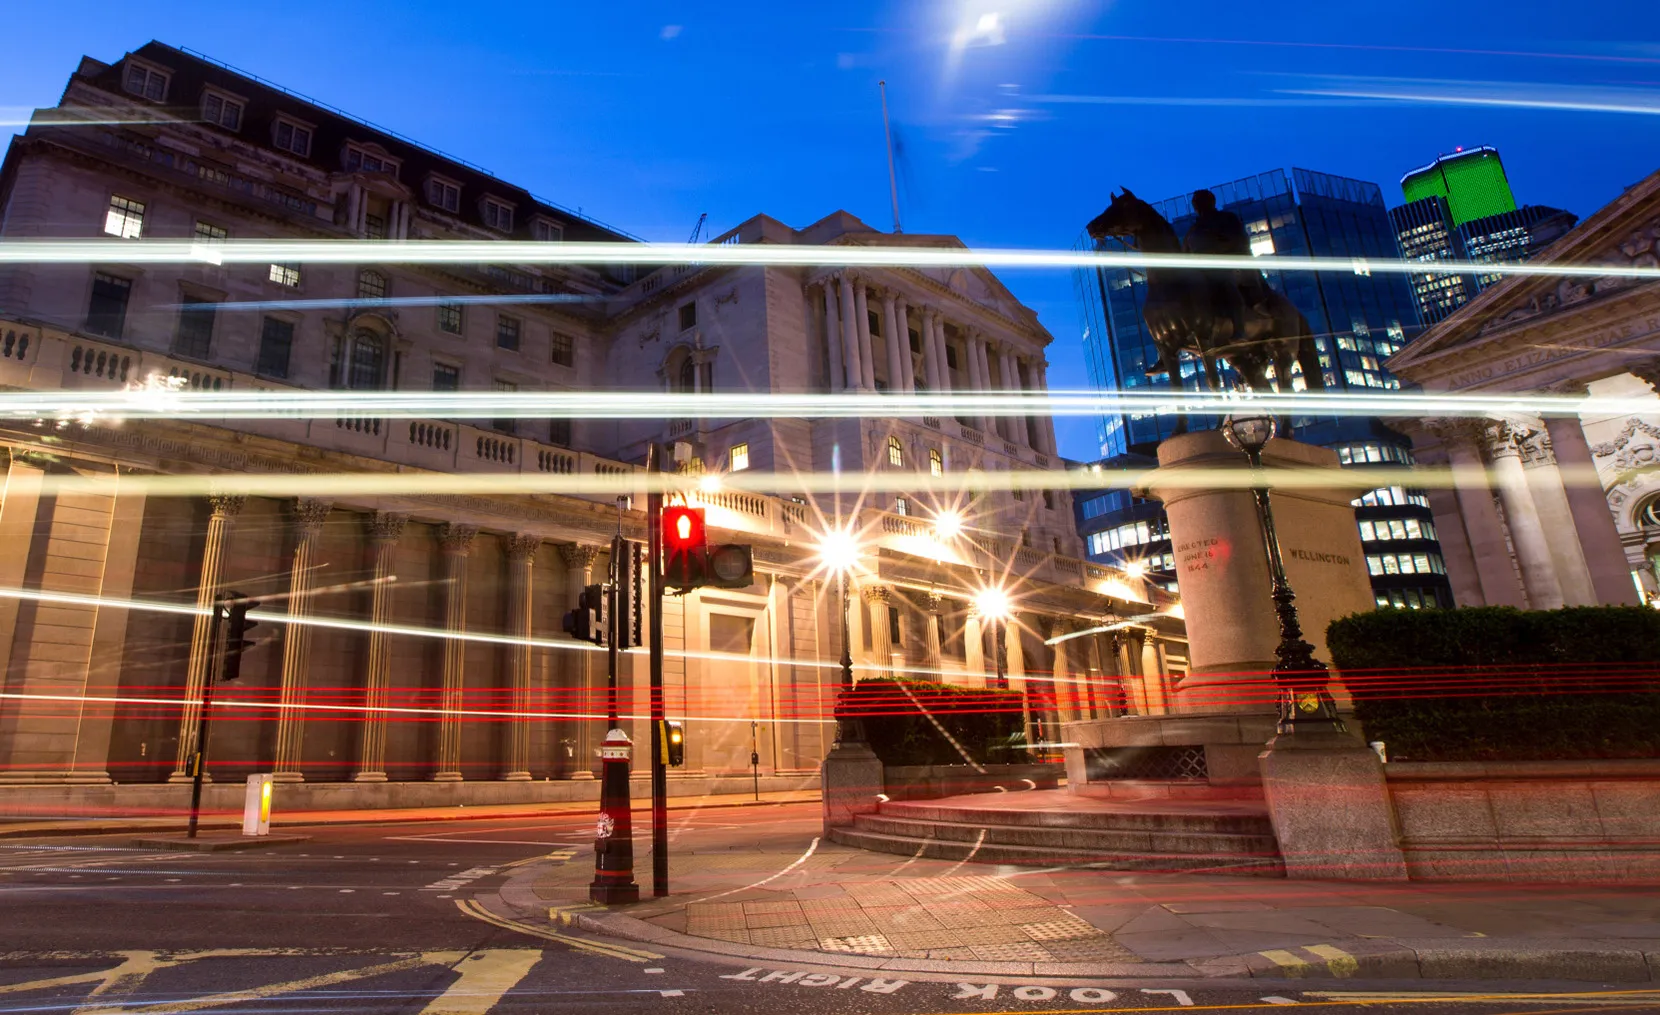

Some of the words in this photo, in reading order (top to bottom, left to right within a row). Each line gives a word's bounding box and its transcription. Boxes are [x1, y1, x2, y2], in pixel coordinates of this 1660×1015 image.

[1449, 367, 1493, 391] ANNO
[1177, 538, 1219, 553] ERECTED
[1184, 551, 1202, 562] JUNE
[1289, 548, 1350, 565] WELLINGTON
[718, 966, 910, 995] RIGHT
[952, 982, 1195, 1007] LOOK
